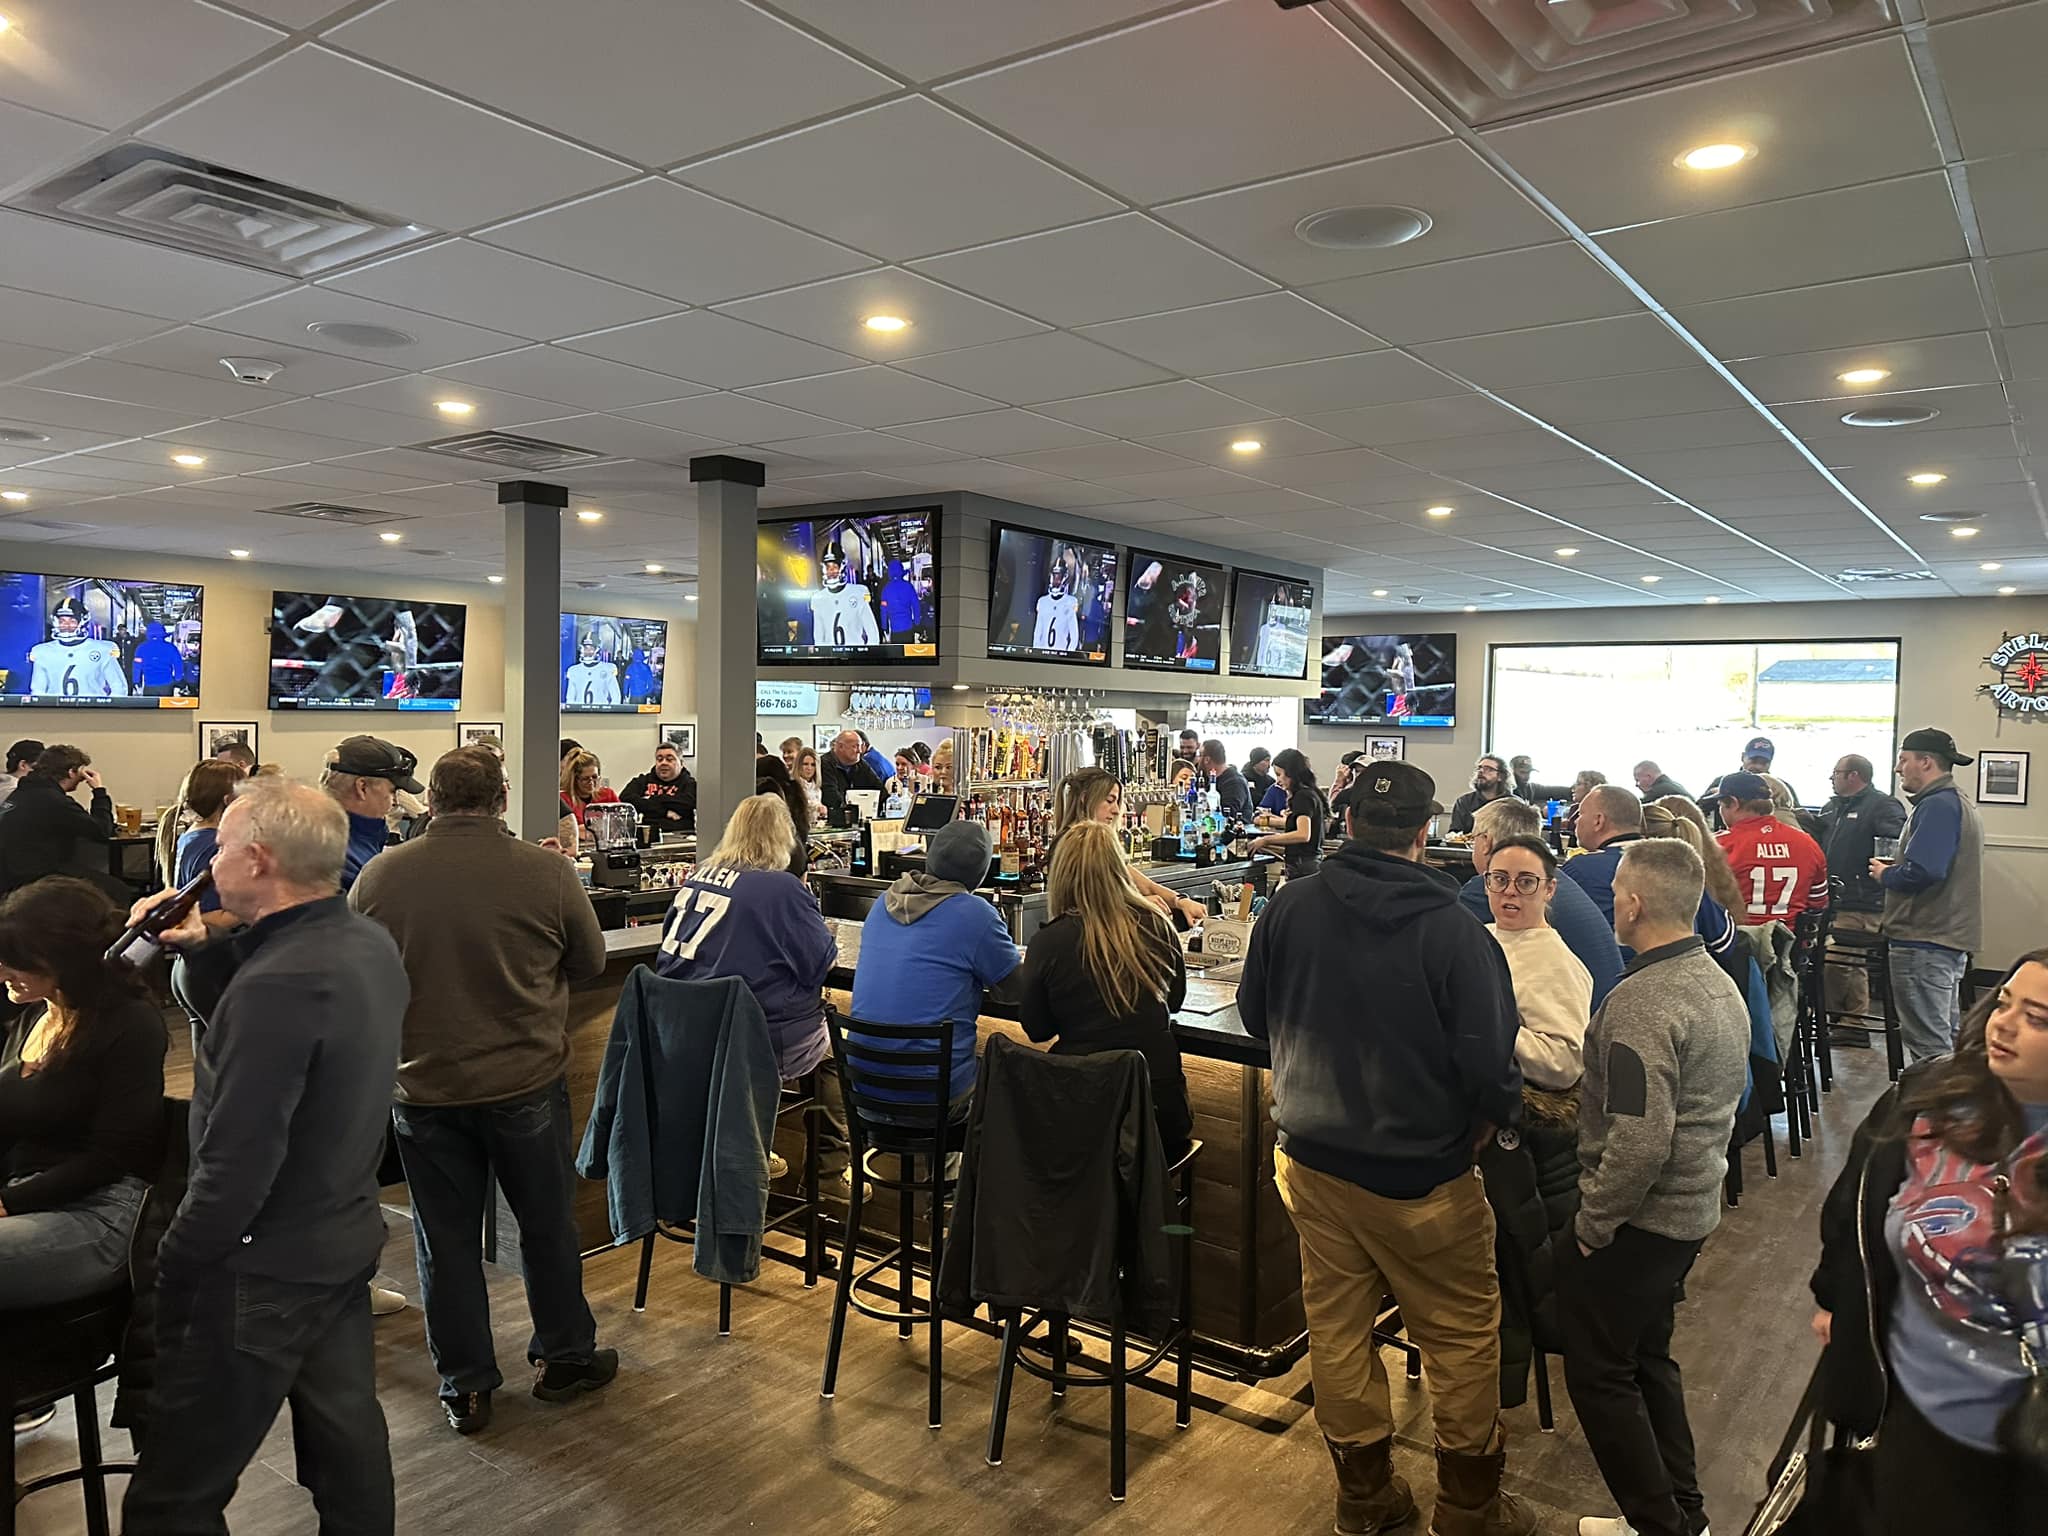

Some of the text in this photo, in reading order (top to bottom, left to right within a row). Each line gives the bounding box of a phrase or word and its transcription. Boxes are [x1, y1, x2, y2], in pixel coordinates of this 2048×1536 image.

[833, 612, 846, 645] 6
[1048, 617, 1057, 647] 6
[1990, 633, 2048, 667] STEL
[62, 664, 80, 695] 6
[584, 681, 594, 704] 6
[1990, 683, 2048, 711] ARTO
[1756, 843, 1790, 859] ALLEN
[689, 865, 741, 889] ALLEN
[1747, 866, 1798, 915] 17
[661, 886, 731, 960] 17
